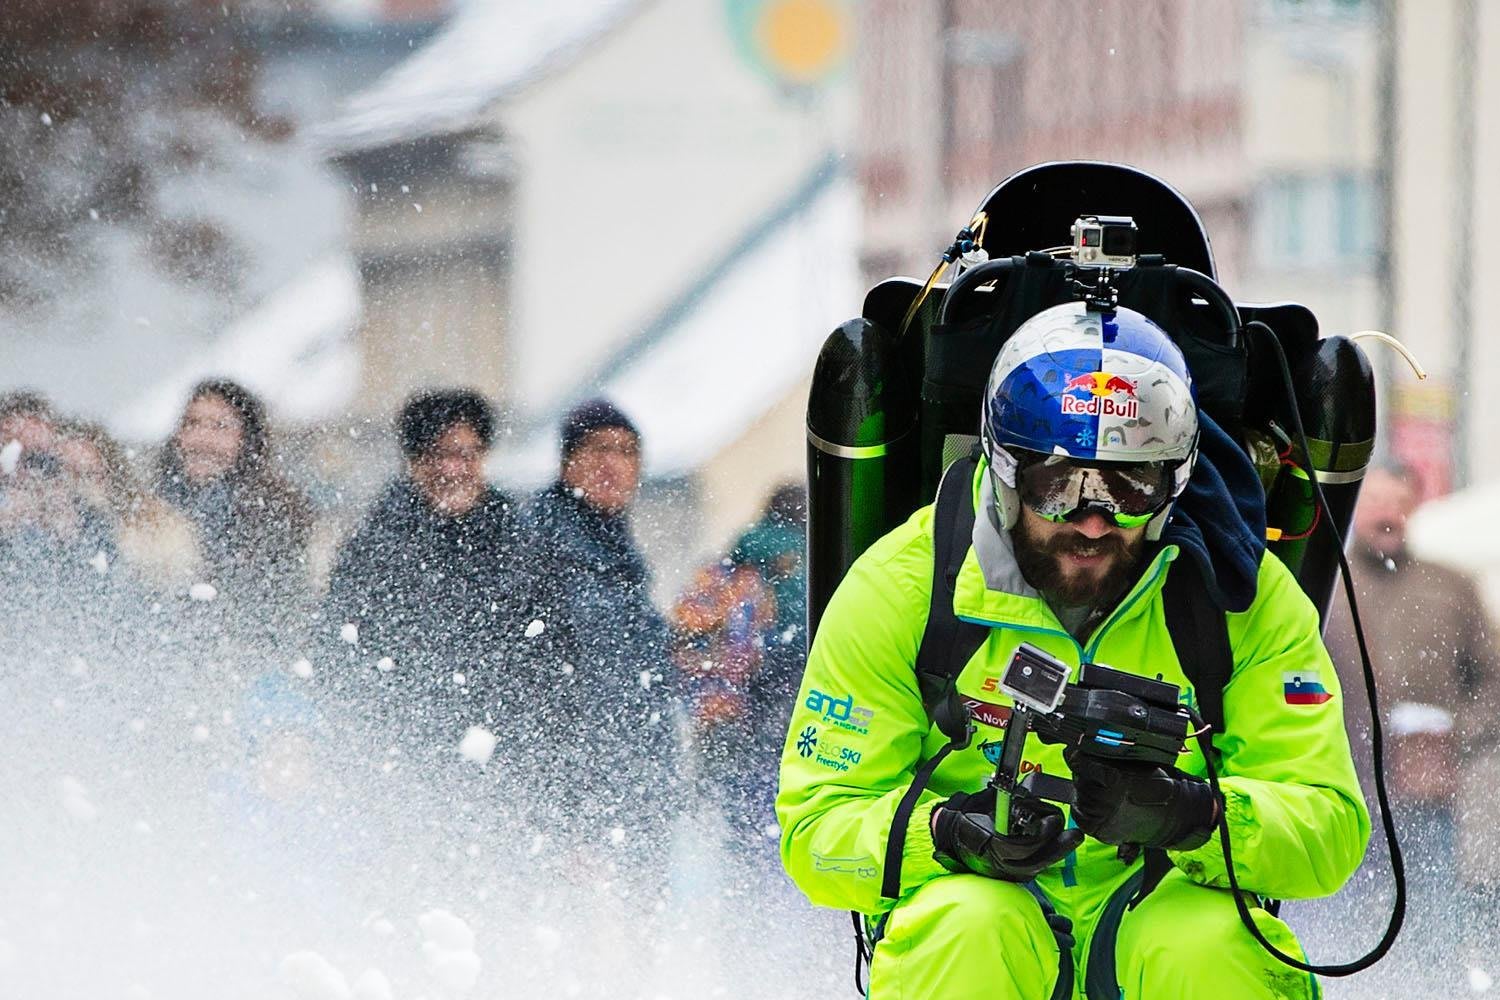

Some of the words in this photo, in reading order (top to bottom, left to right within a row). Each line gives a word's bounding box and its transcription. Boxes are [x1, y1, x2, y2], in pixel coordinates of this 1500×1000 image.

[1062, 395, 1099, 414] Red
[1103, 398, 1137, 418] Bull
[983, 712, 1009, 727] Nov
[816, 753, 849, 772] Freestyle
